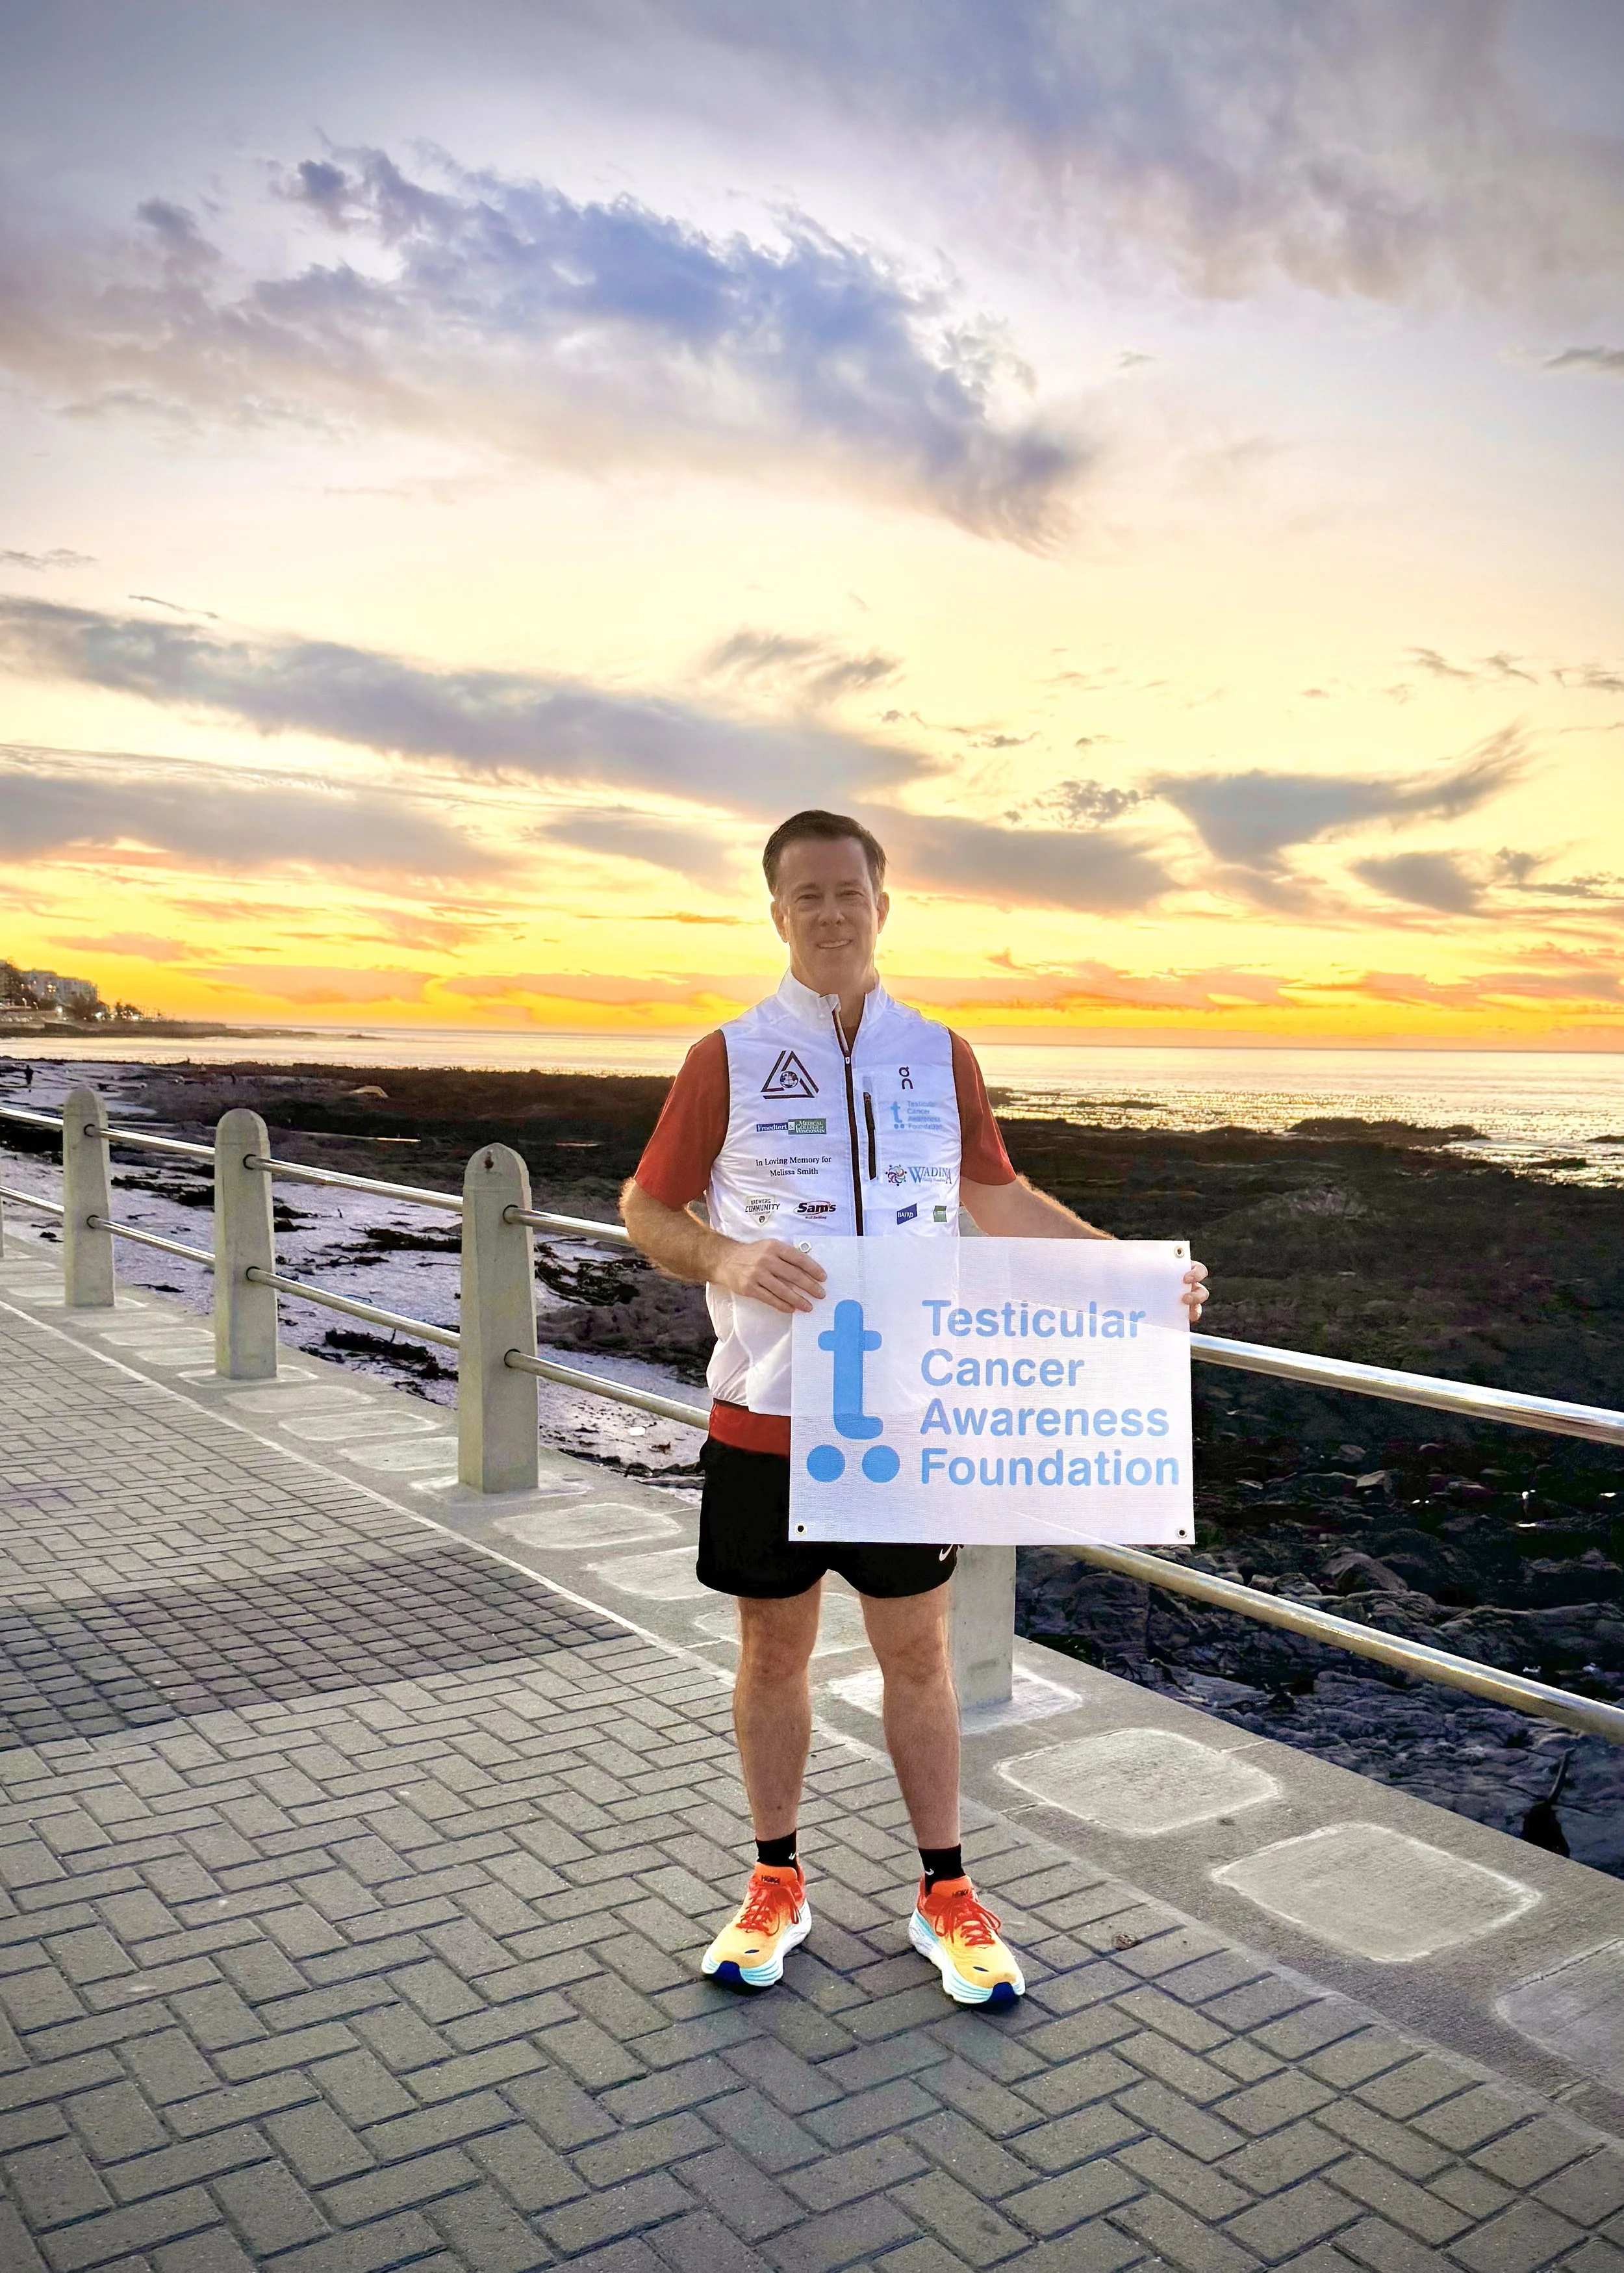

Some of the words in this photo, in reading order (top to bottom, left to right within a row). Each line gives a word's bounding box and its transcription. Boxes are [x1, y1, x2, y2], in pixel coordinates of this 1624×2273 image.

[745, 1203, 780, 1212] COMMUNITY
[922, 1300, 1147, 1339] Testicular
[921, 1348, 1085, 1387] Cancer
[920, 1398, 1170, 1437] Awareness
[921, 1448, 1180, 1486] Foundation
